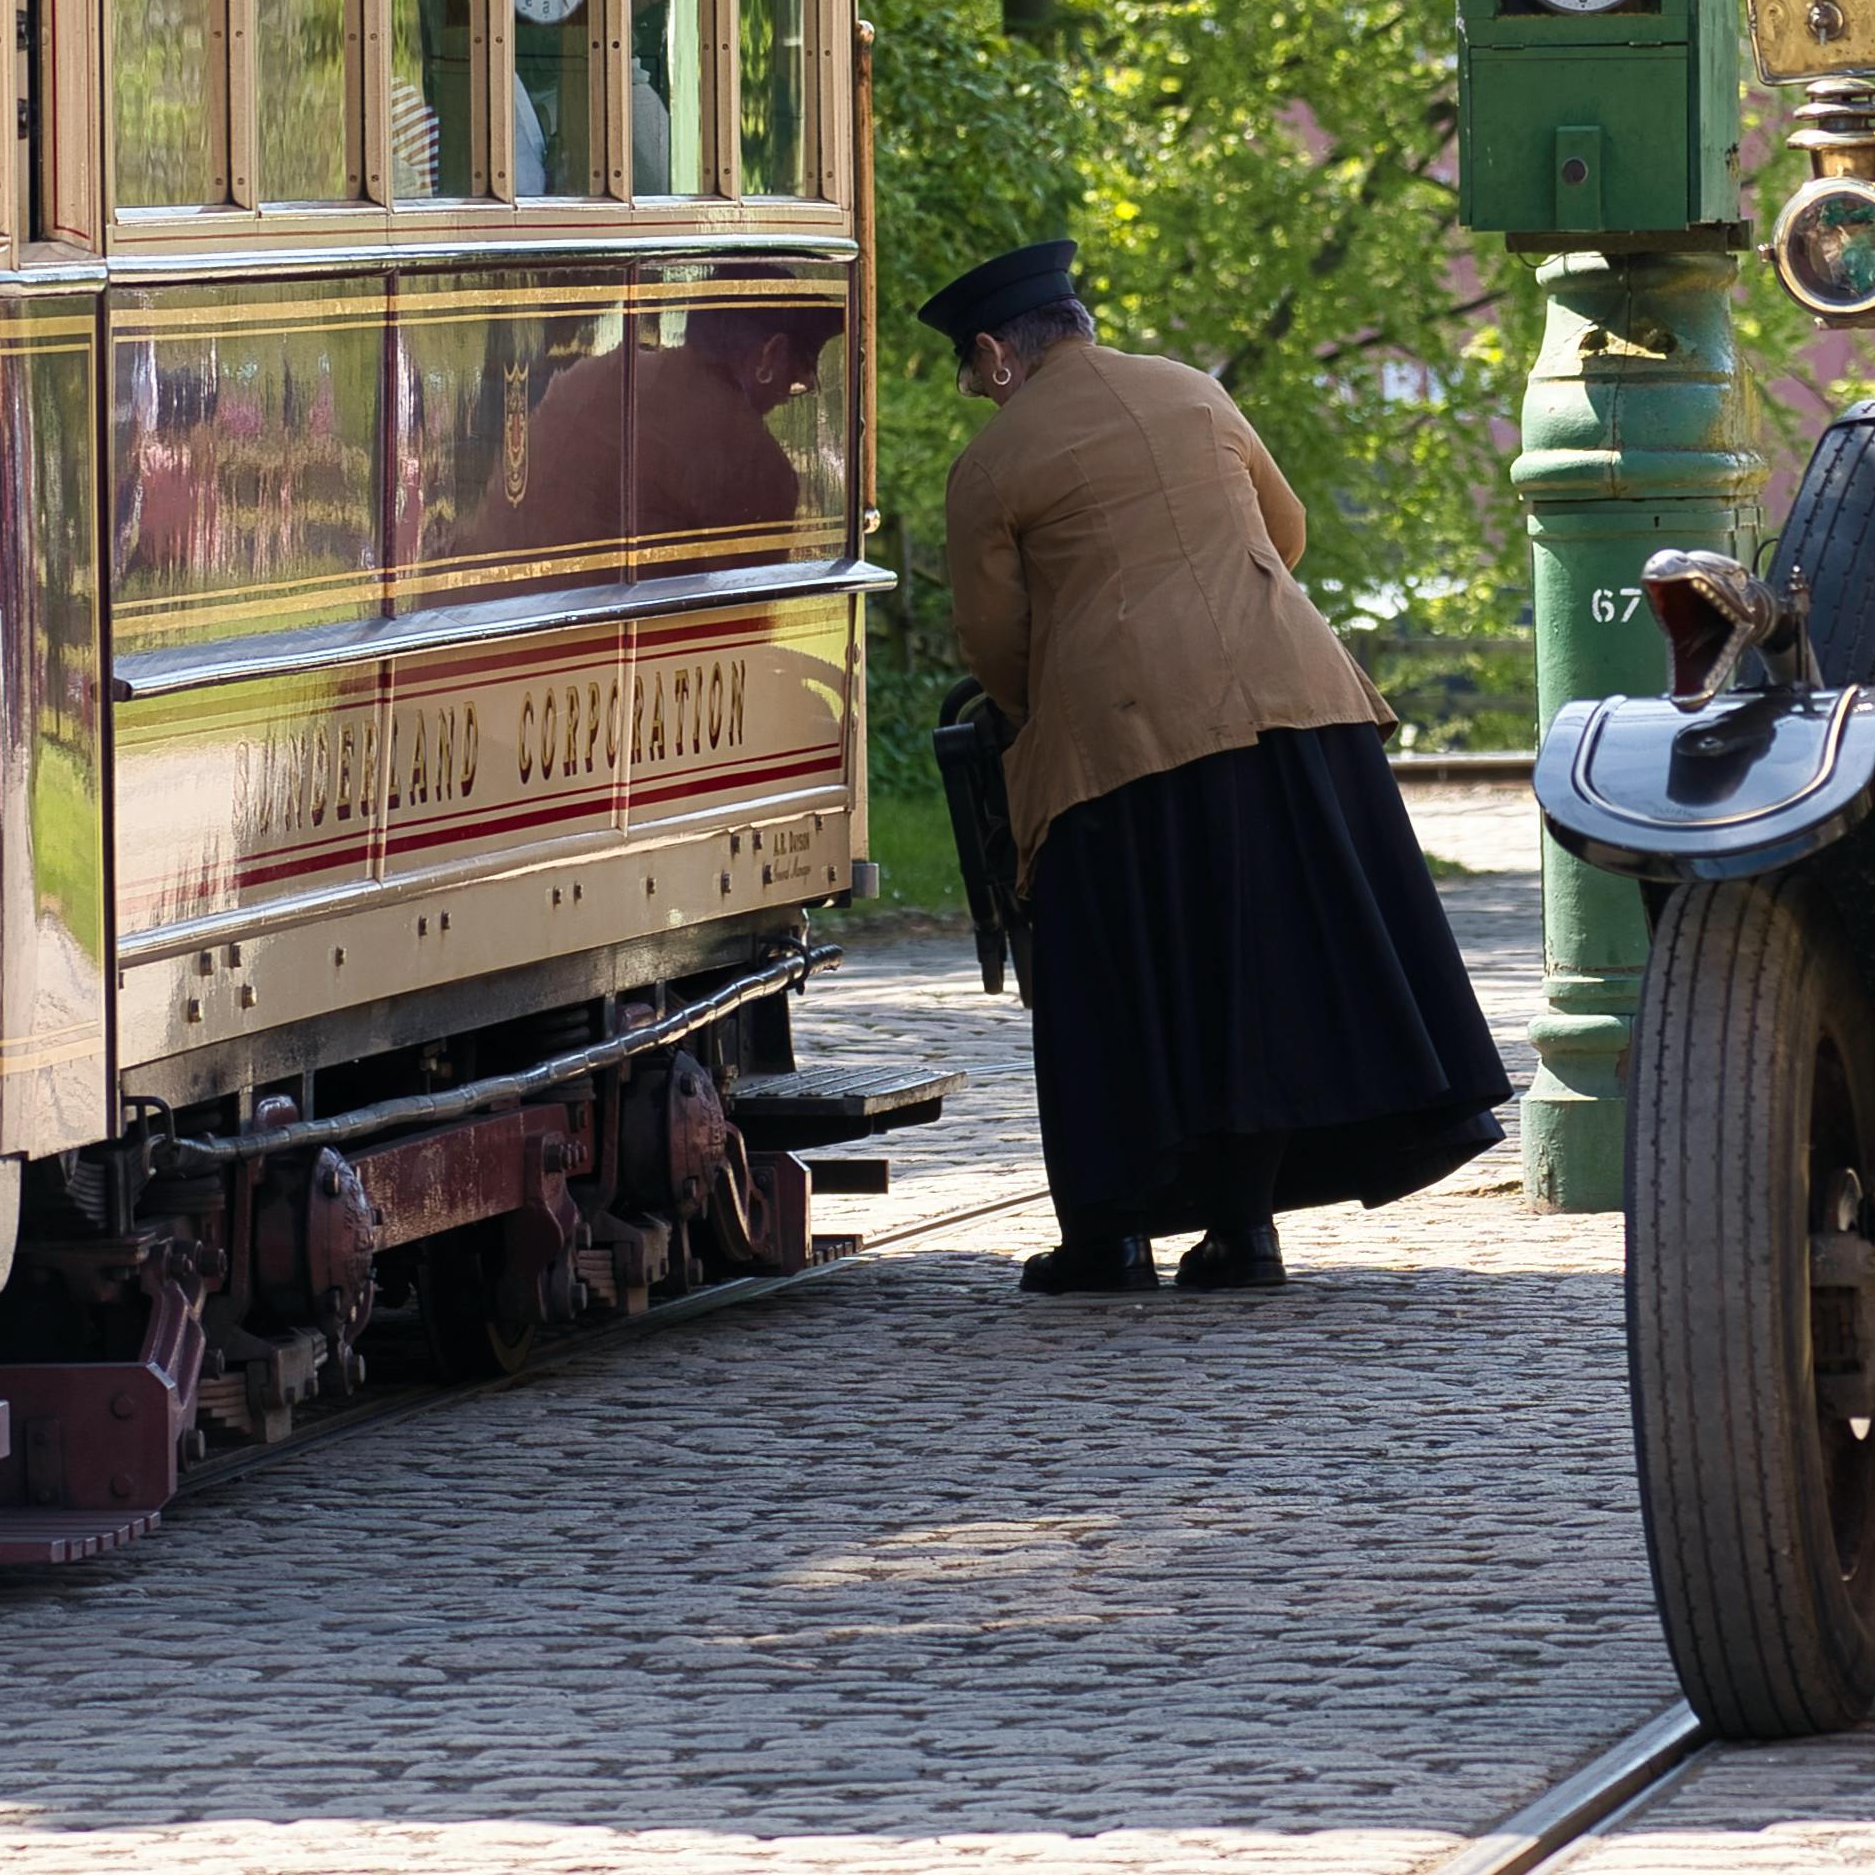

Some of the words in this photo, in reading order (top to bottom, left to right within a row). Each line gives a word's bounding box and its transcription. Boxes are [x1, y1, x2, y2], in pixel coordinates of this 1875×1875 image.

[1591, 587, 1643, 623] 67
[232, 700, 479, 836] SUNDERLAND
[518, 660, 747, 785] CORPORATION
